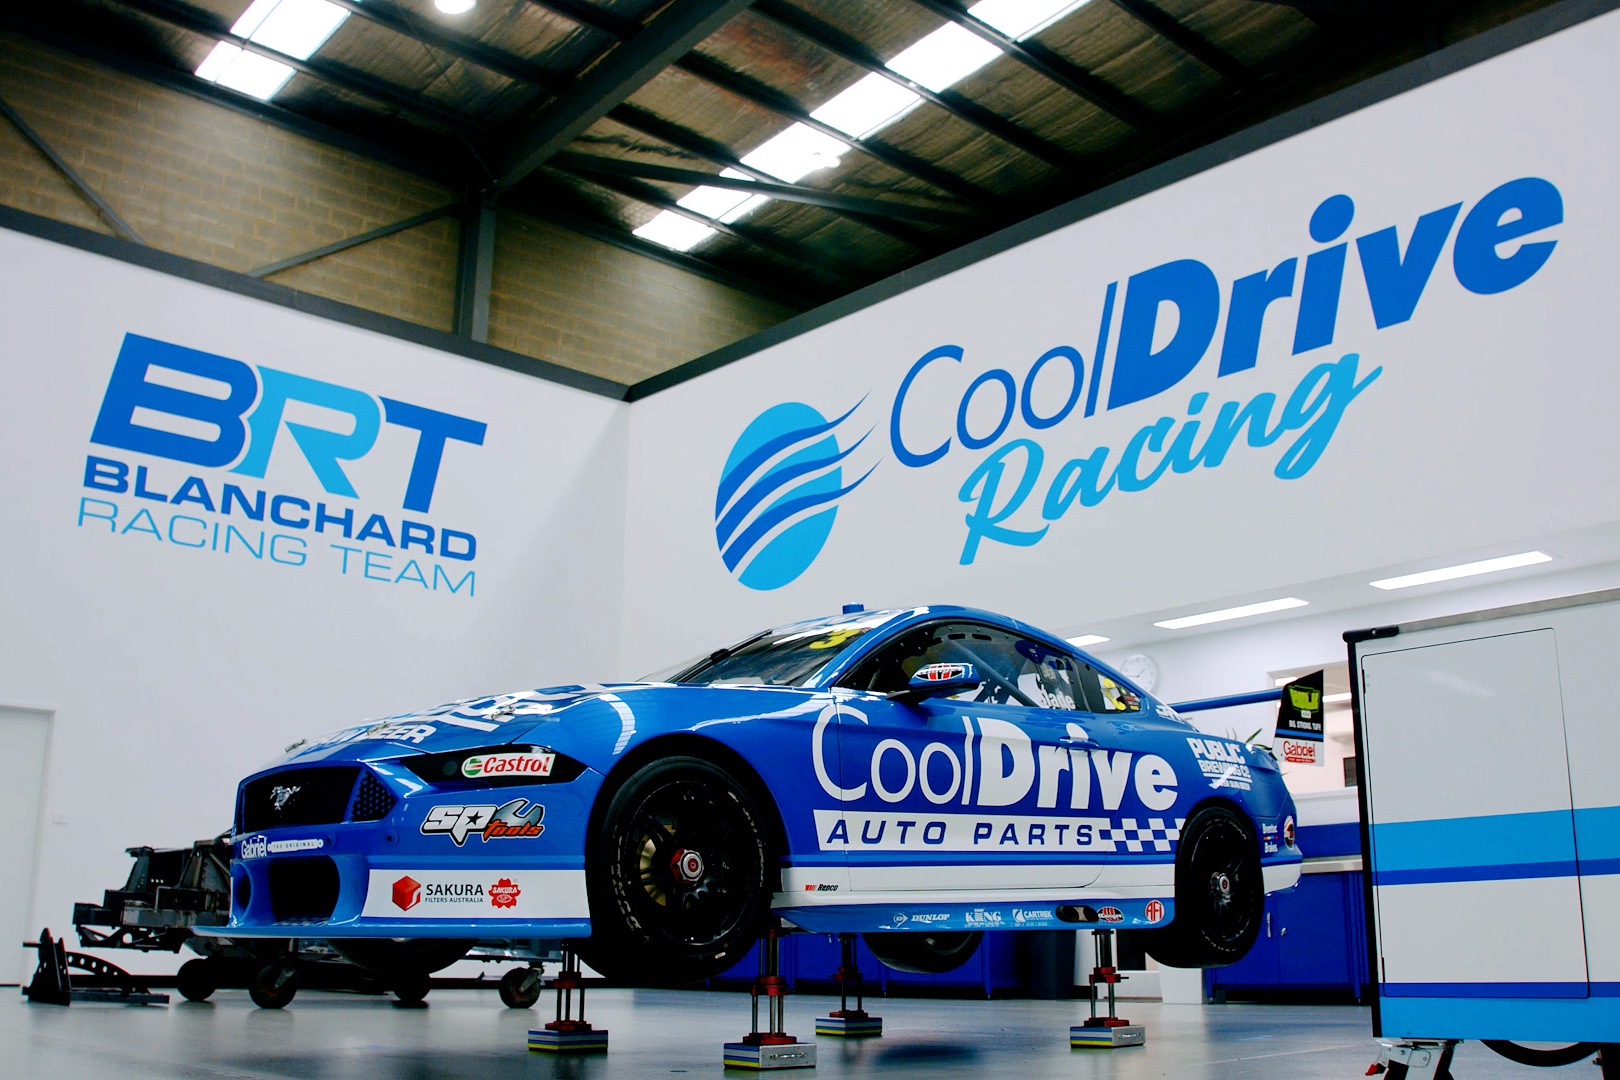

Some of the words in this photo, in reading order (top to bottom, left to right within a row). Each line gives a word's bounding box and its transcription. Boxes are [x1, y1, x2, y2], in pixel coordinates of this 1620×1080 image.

[889, 177, 1564, 468] CoolDrive
[90, 332, 488, 514] BRT
[957, 353, 1383, 566] Racing
[83, 455, 477, 561] BLANCHARD
[77, 497, 307, 567] RACING
[330, 544, 476, 597] TEAM
[812, 705, 1178, 811] CoolDrive
[1186, 737, 1246, 765] PUBLIC
[1283, 740, 1316, 757] Gabriel
[484, 756, 550, 773] Castrol
[482, 819, 544, 842] tools
[826, 819, 948, 845] AUTO
[973, 822, 1093, 846] PARTS
[241, 835, 267, 859] Gabriel
[285, 841, 315, 849] ORIGINAL
[426, 884, 484, 896] SAKURA
[492, 886, 518, 894] SAKURA
[911, 914, 951, 922] DUNLOP
[965, 908, 1002, 923] KING
[1023, 910, 1053, 919] CARTREK
